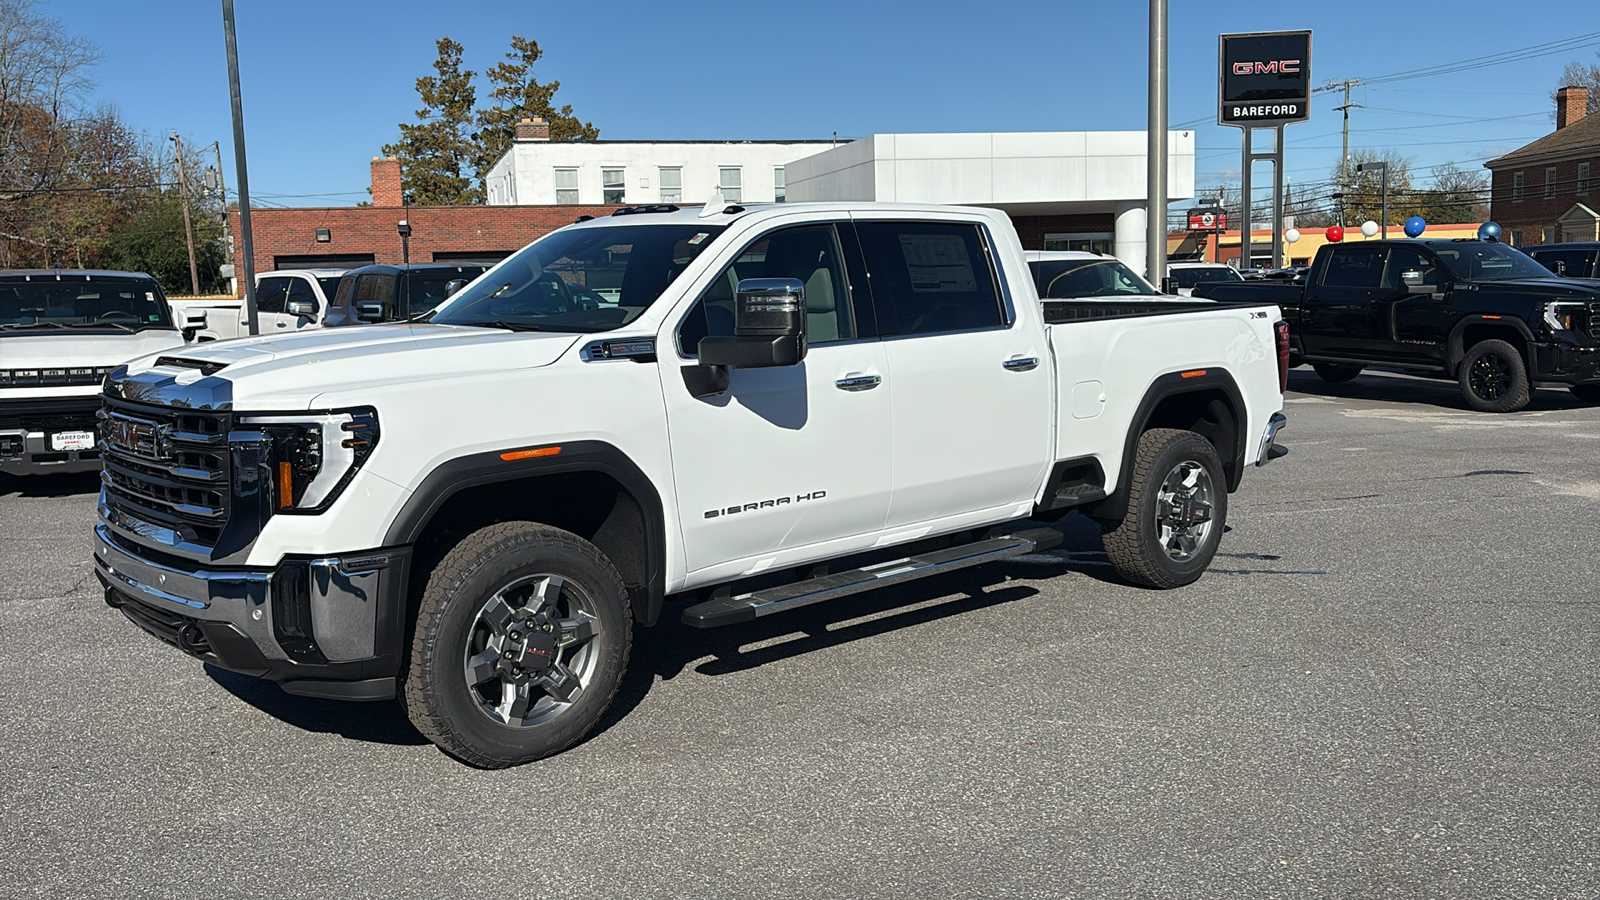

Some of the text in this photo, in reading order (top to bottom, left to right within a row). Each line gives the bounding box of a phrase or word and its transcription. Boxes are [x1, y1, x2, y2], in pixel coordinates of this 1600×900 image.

[1233, 60, 1300, 75] GMC
[1233, 105, 1297, 117] BAREFORD
[107, 419, 154, 453] GMC
[704, 490, 826, 519] SIERRA HD
